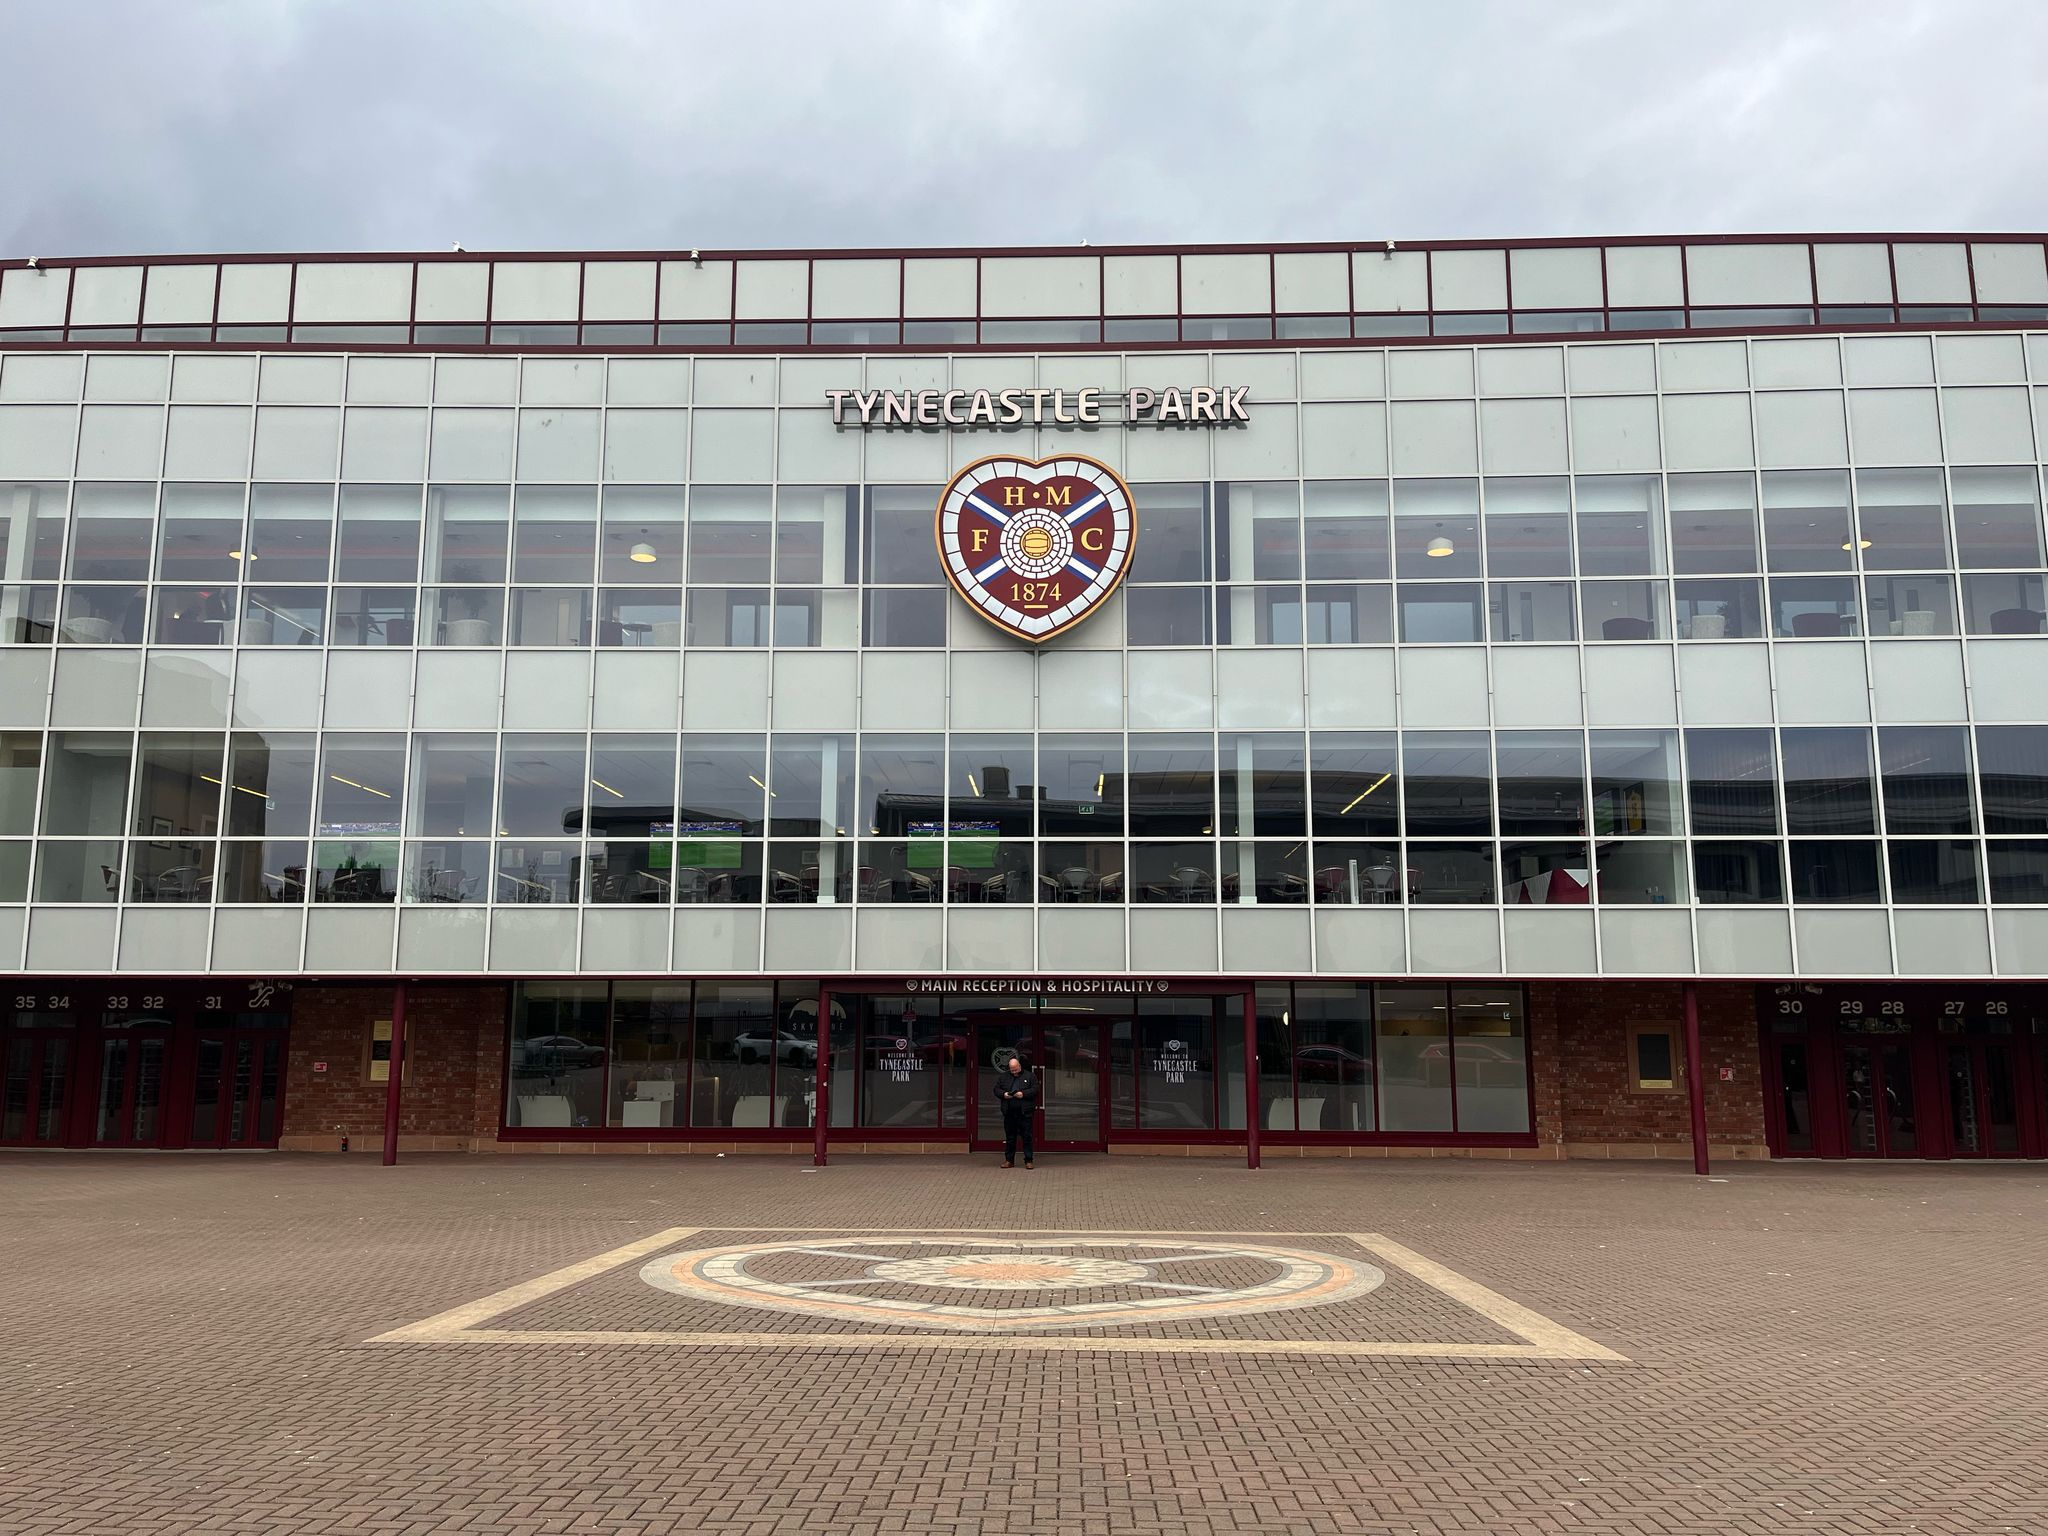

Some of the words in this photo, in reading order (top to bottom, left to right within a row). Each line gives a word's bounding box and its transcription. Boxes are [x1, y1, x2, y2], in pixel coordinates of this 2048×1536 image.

[825, 388, 1101, 424] TYNECASTLE
[1129, 386, 1250, 422] PARK
[971, 529, 989, 552] F
[1080, 528, 1103, 551] C
[1010, 583, 1062, 602] 1874
[921, 980, 957, 992] MAIN
[963, 980, 1041, 992] RECEPTION
[1047, 980, 1057, 992] &
[1062, 980, 1154, 992] HOSPITALITY
[15, 996, 36, 1009] 35
[48, 996, 70, 1009] 34
[107, 996, 129, 1009] 33
[142, 996, 164, 1009] 32
[204, 996, 222, 1009] 31
[1779, 1001, 1803, 1014] 30
[1840, 1001, 1864, 1014] 29
[1881, 1001, 1905, 1015] 28
[1944, 1001, 1965, 1015] 27
[1985, 1001, 2008, 1015] 26
[792, 1022, 844, 1031] SKYNE
[880, 1058, 924, 1070] TYNECASTLE
[1152, 1060, 1198, 1072] TYNECASTLE
[892, 1070, 910, 1082] PARK
[1166, 1072, 1184, 1083] PARK
